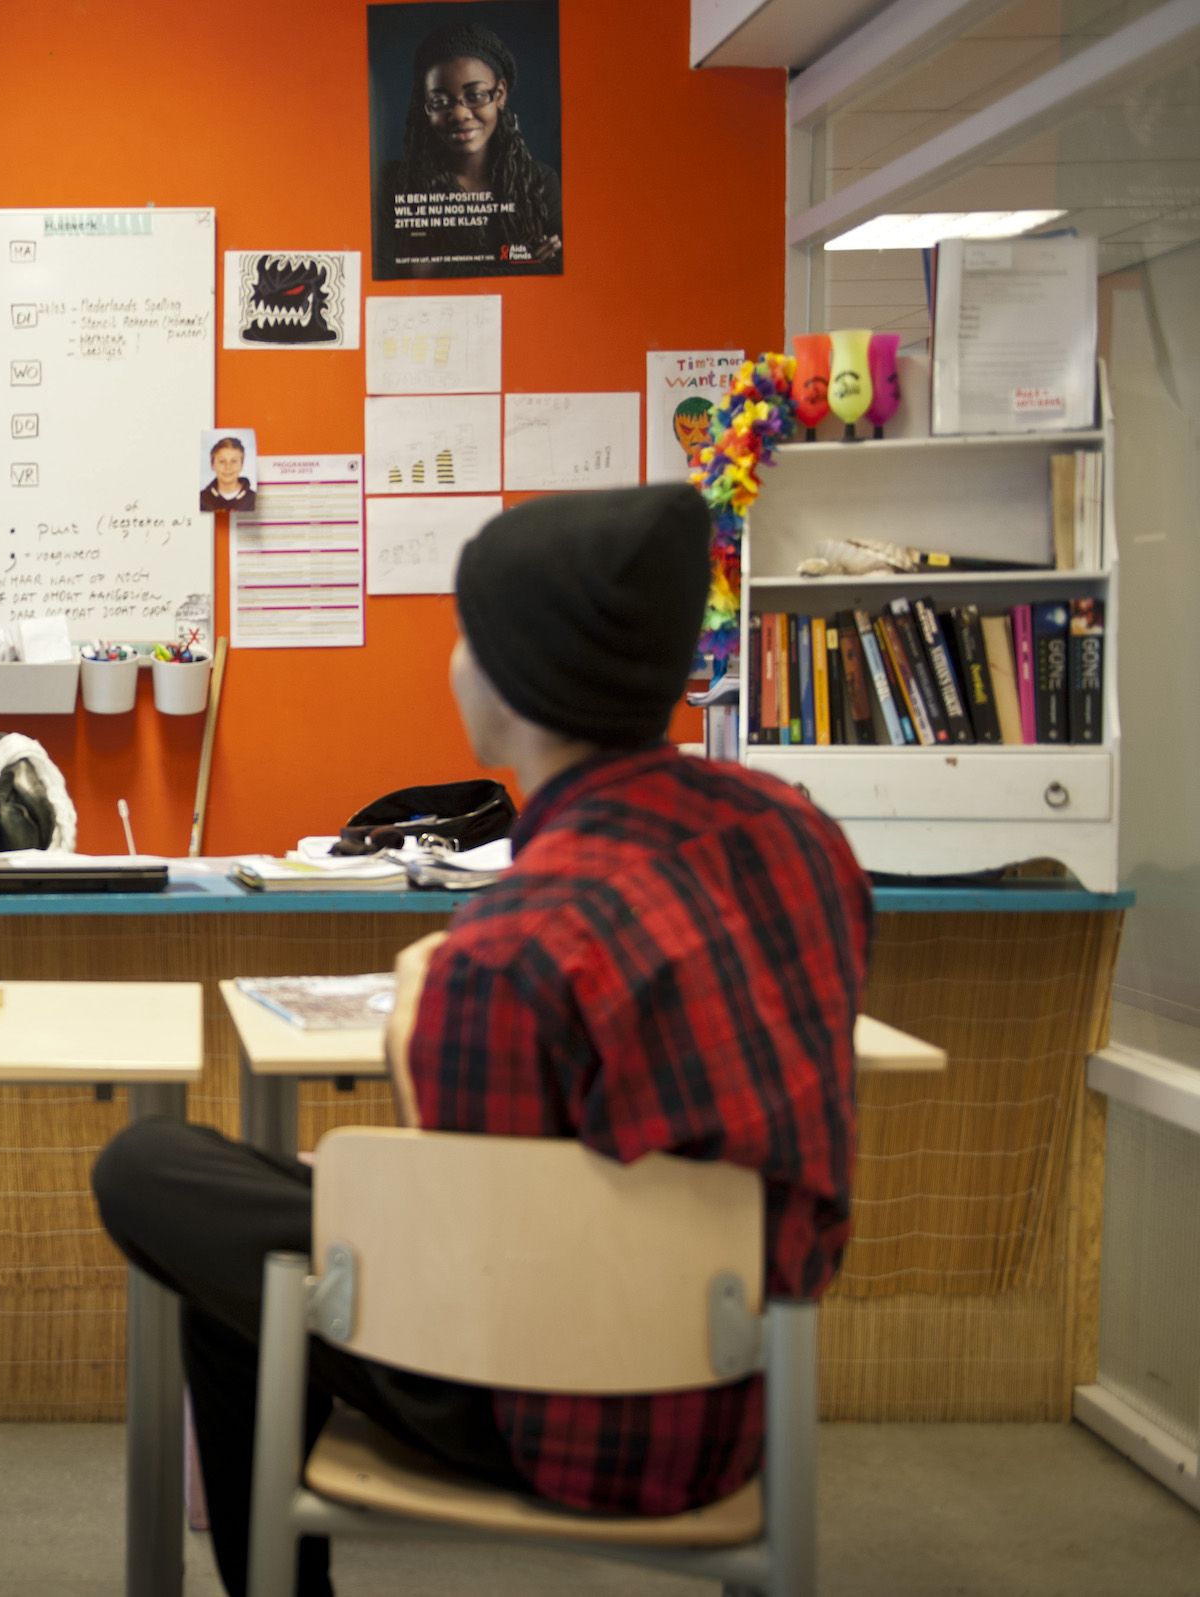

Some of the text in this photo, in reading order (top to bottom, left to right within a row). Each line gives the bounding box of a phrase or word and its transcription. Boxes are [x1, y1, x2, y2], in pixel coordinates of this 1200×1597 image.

[394, 191, 494, 204] IK BEN HIV-POSITIEF.
[394, 202, 516, 216] WIL JE NU NOG NAAST ME
[394, 216, 488, 229] ZITTEN IN DE KLAS?
[509, 244, 527, 253] Aids
[509, 252, 532, 261] Fonds
[13, 364, 38, 379] WO
[15, 418, 36, 434] DO
[13, 467, 35, 485] VR
[1049, 639, 1066, 691] GONE
[1082, 638, 1100, 690] GONE
